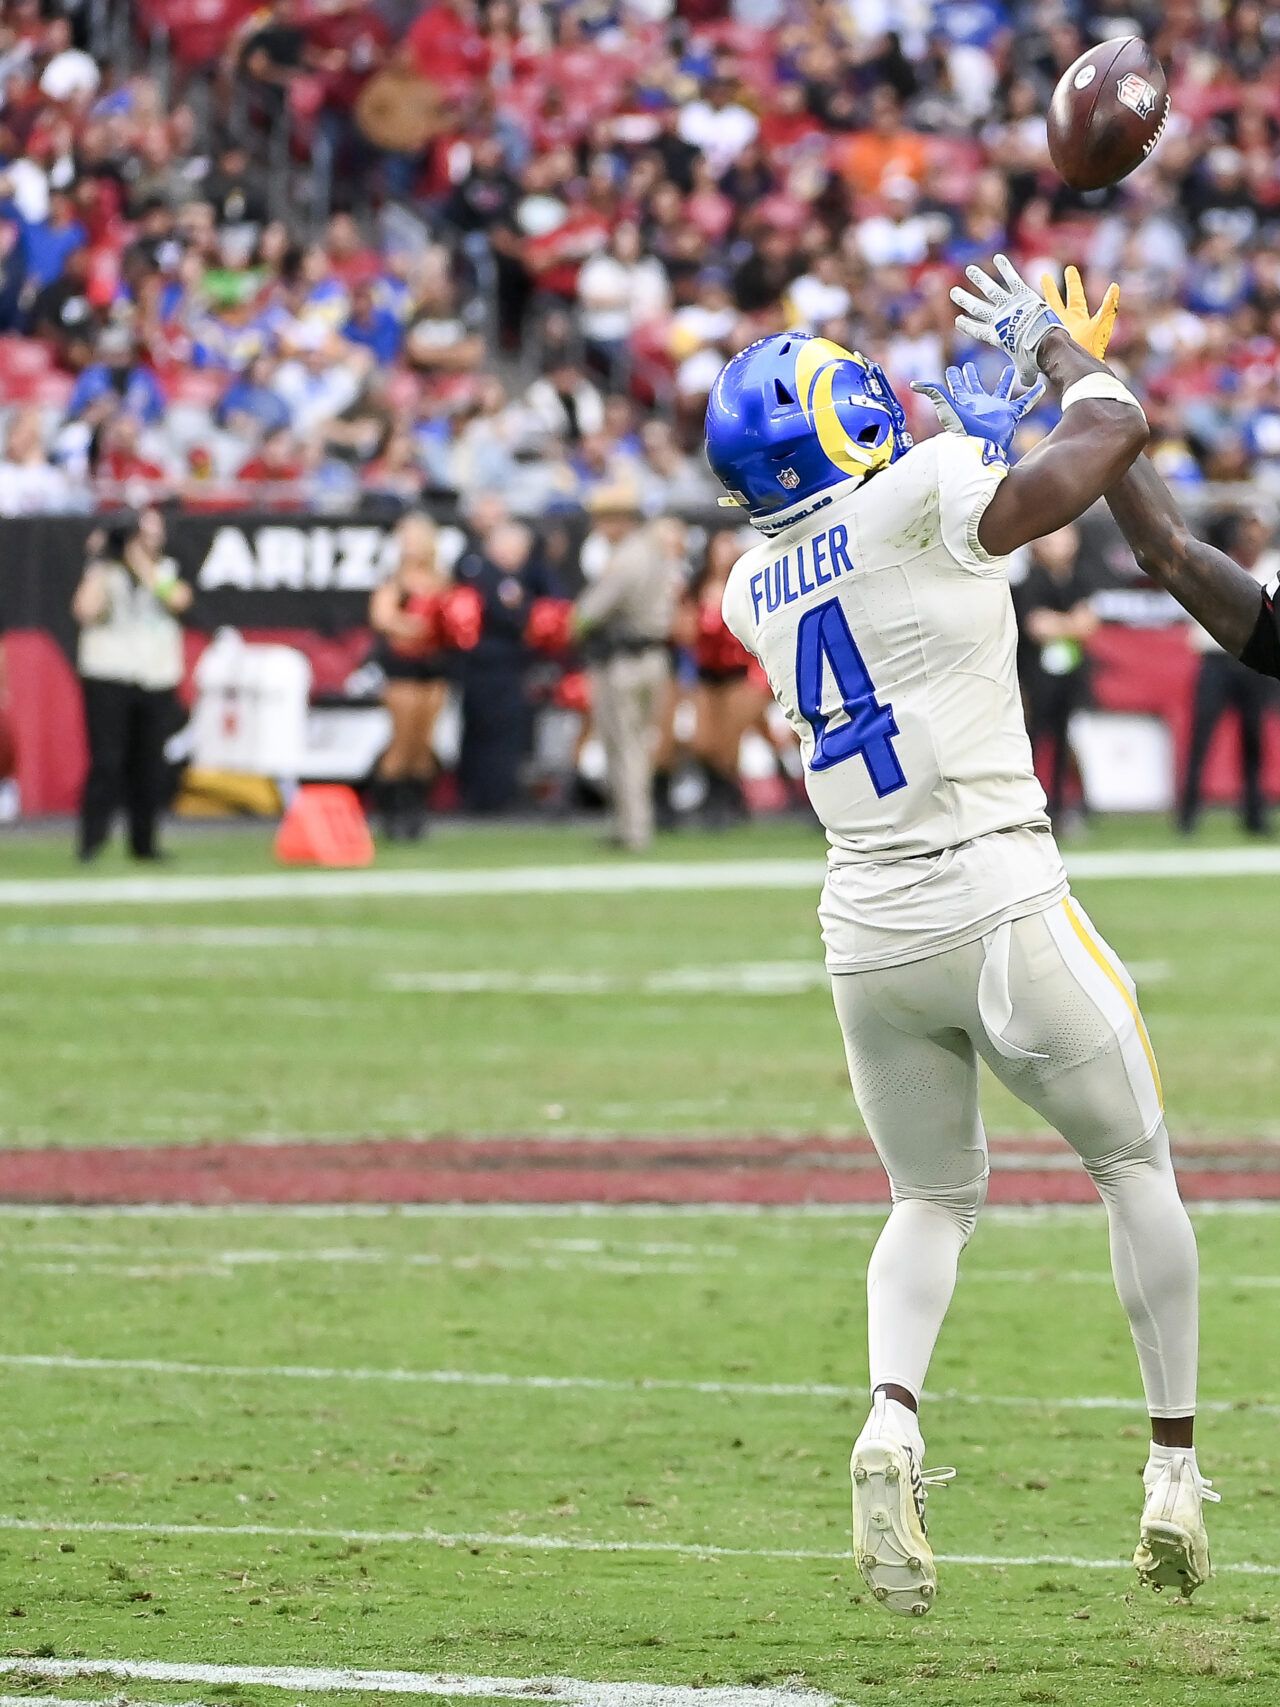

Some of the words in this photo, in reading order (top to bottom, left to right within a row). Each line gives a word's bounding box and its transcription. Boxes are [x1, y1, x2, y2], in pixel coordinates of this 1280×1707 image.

[1007, 309, 1023, 354] adidas
[750, 524, 854, 627] FULLER
[795, 596, 907, 799] 4
